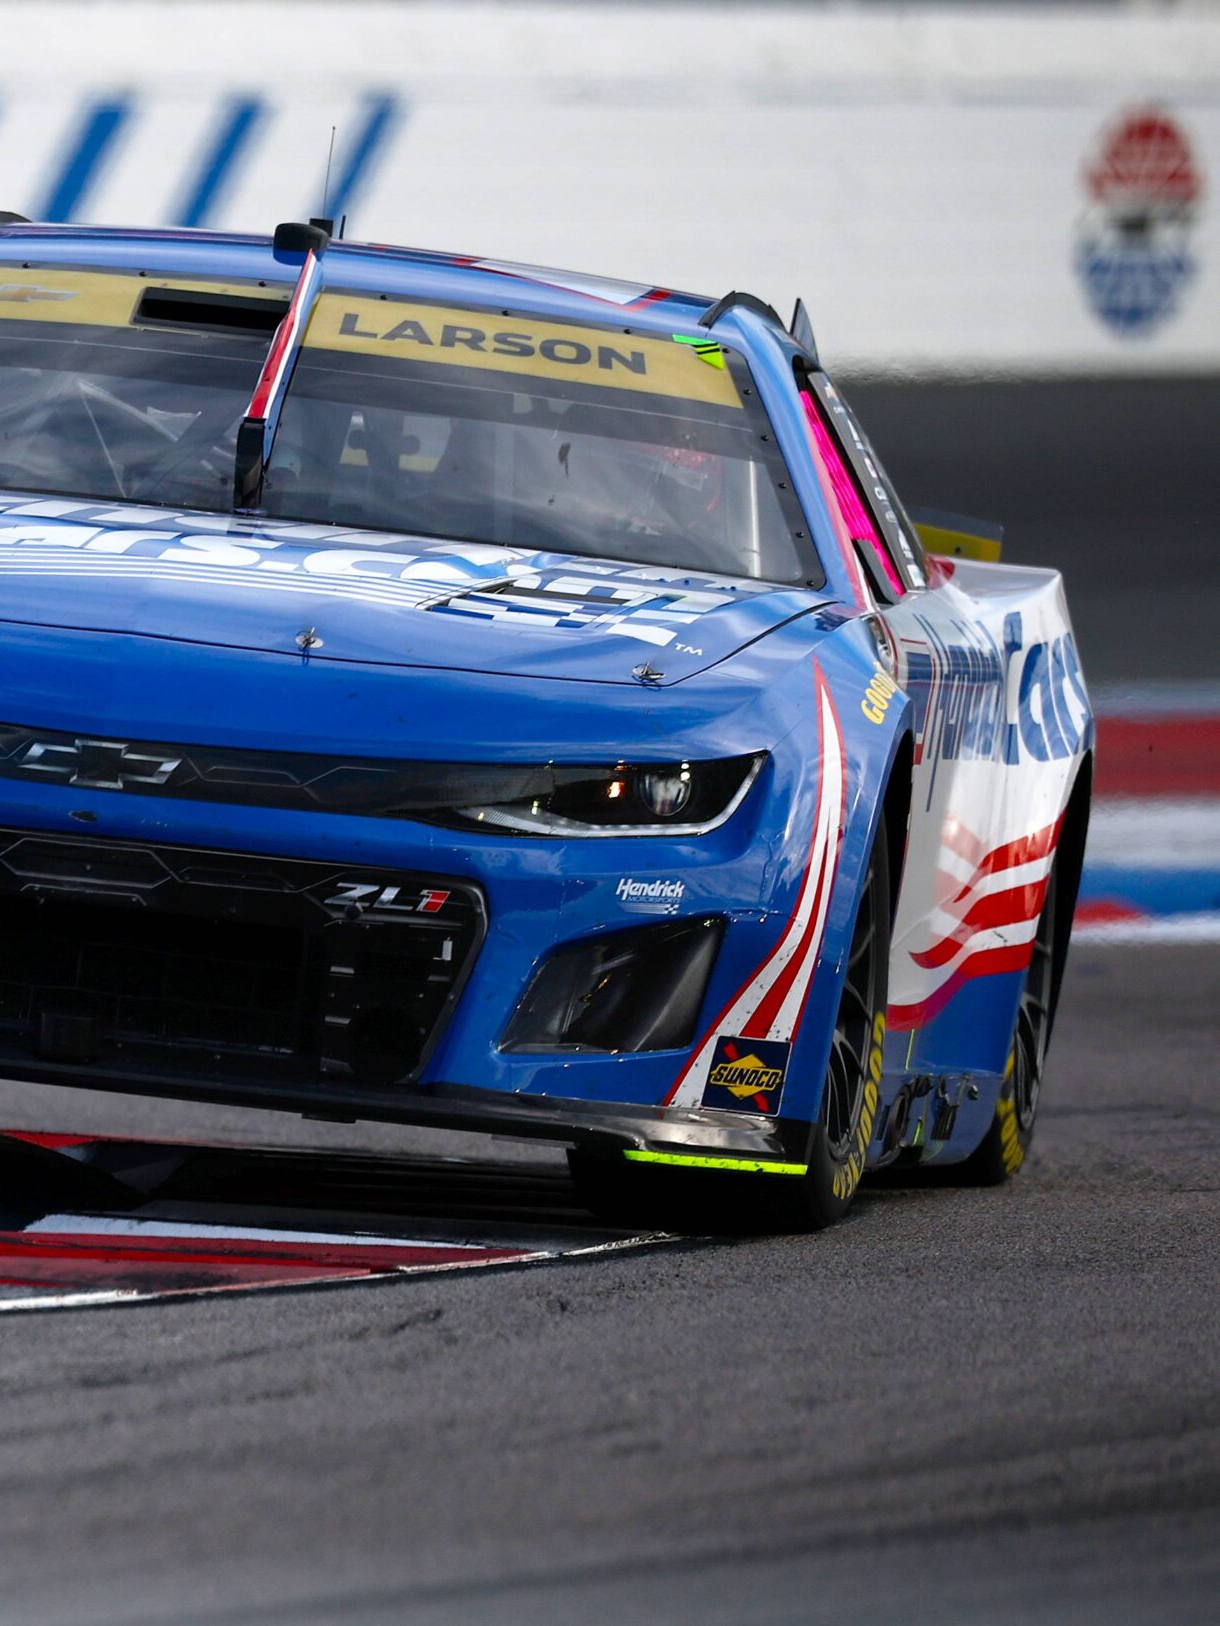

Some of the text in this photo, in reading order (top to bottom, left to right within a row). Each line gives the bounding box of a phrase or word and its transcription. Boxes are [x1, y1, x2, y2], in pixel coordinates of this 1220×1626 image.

[338, 312, 647, 375] LARSON
[323, 882, 451, 913] ZL1
[615, 878, 685, 901] Hendrick
[711, 1065, 781, 1090] SUNOCO
